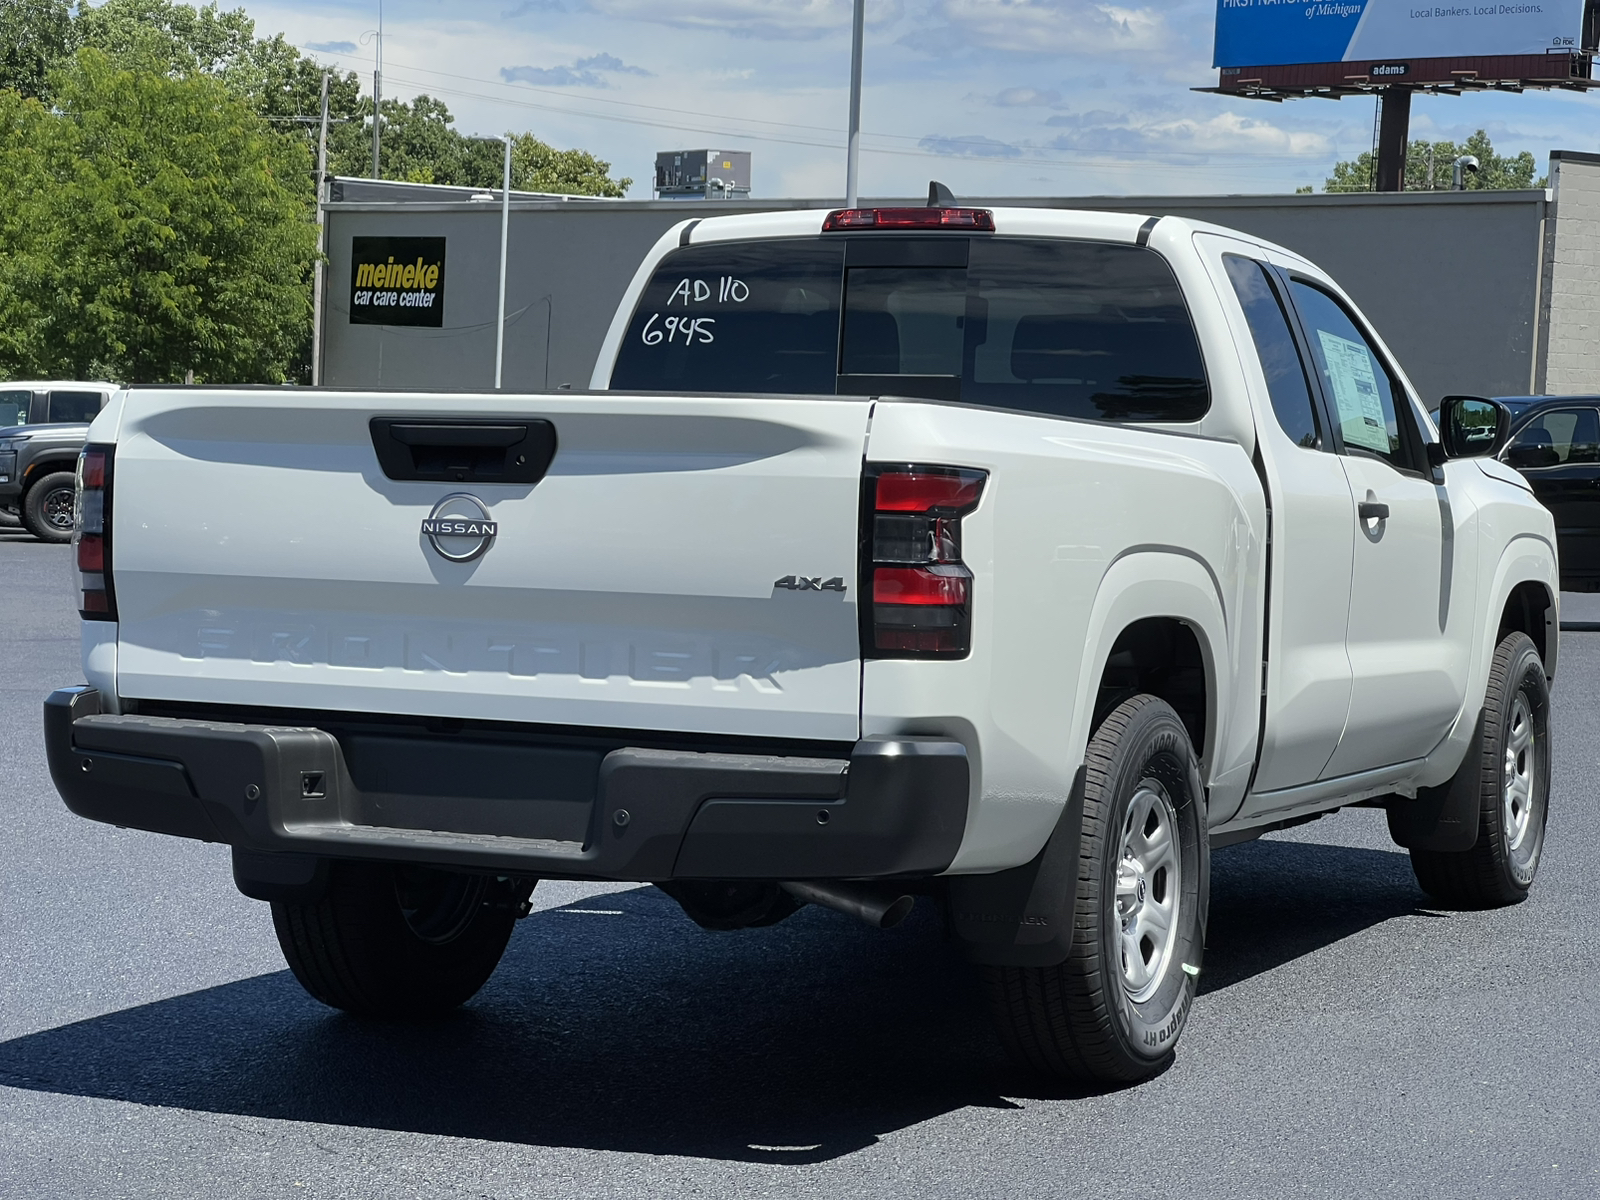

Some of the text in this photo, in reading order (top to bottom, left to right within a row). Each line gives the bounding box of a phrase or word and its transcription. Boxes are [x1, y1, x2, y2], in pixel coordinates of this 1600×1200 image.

[1305, 3, 1361, 19] of Michigan
[1410, 3, 1543, 18] Local Bankers. Local Decisions.
[1373, 64, 1405, 75] adams
[355, 256, 439, 289] meineke
[354, 288, 436, 307] car care center
[667, 275, 750, 306] AD 110
[641, 313, 716, 346] 6945
[423, 522, 495, 535] NISSAN
[178, 616, 786, 694] FRONTIER
